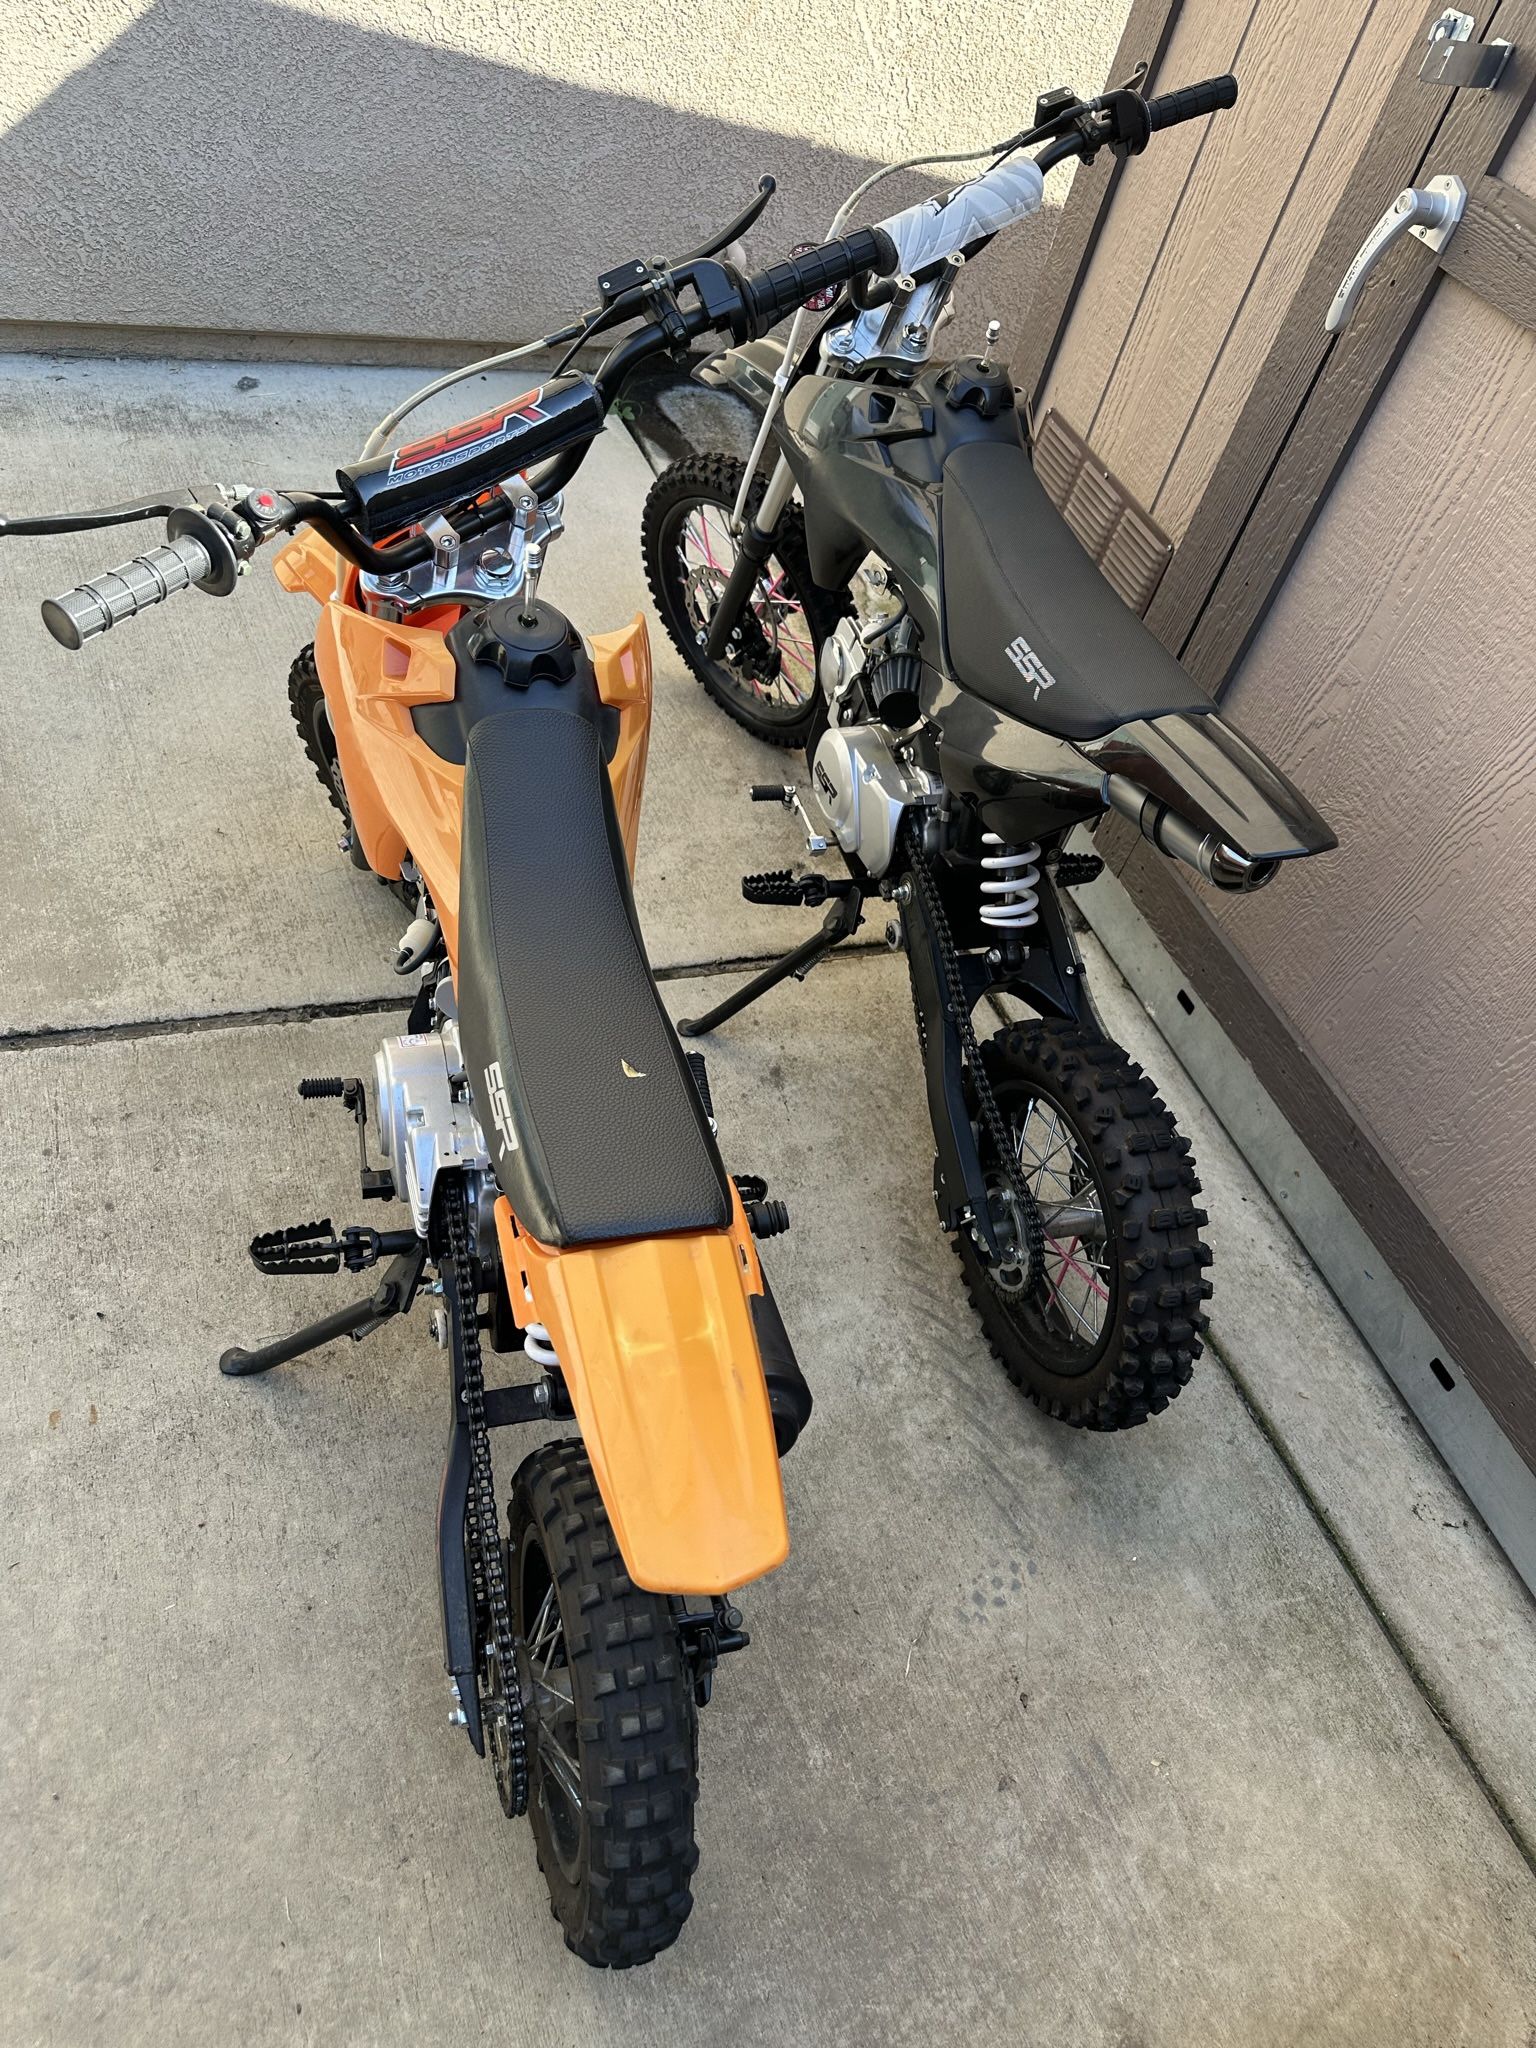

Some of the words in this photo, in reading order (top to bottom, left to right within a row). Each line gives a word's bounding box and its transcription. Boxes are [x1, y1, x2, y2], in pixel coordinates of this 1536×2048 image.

[387, 424, 529, 486] MOTORSPORTS
[391, 387, 551, 474] SSR
[1004, 636, 1056, 702] SSR
[815, 760, 838, 806] SSR
[484, 1061, 519, 1162] SSR
